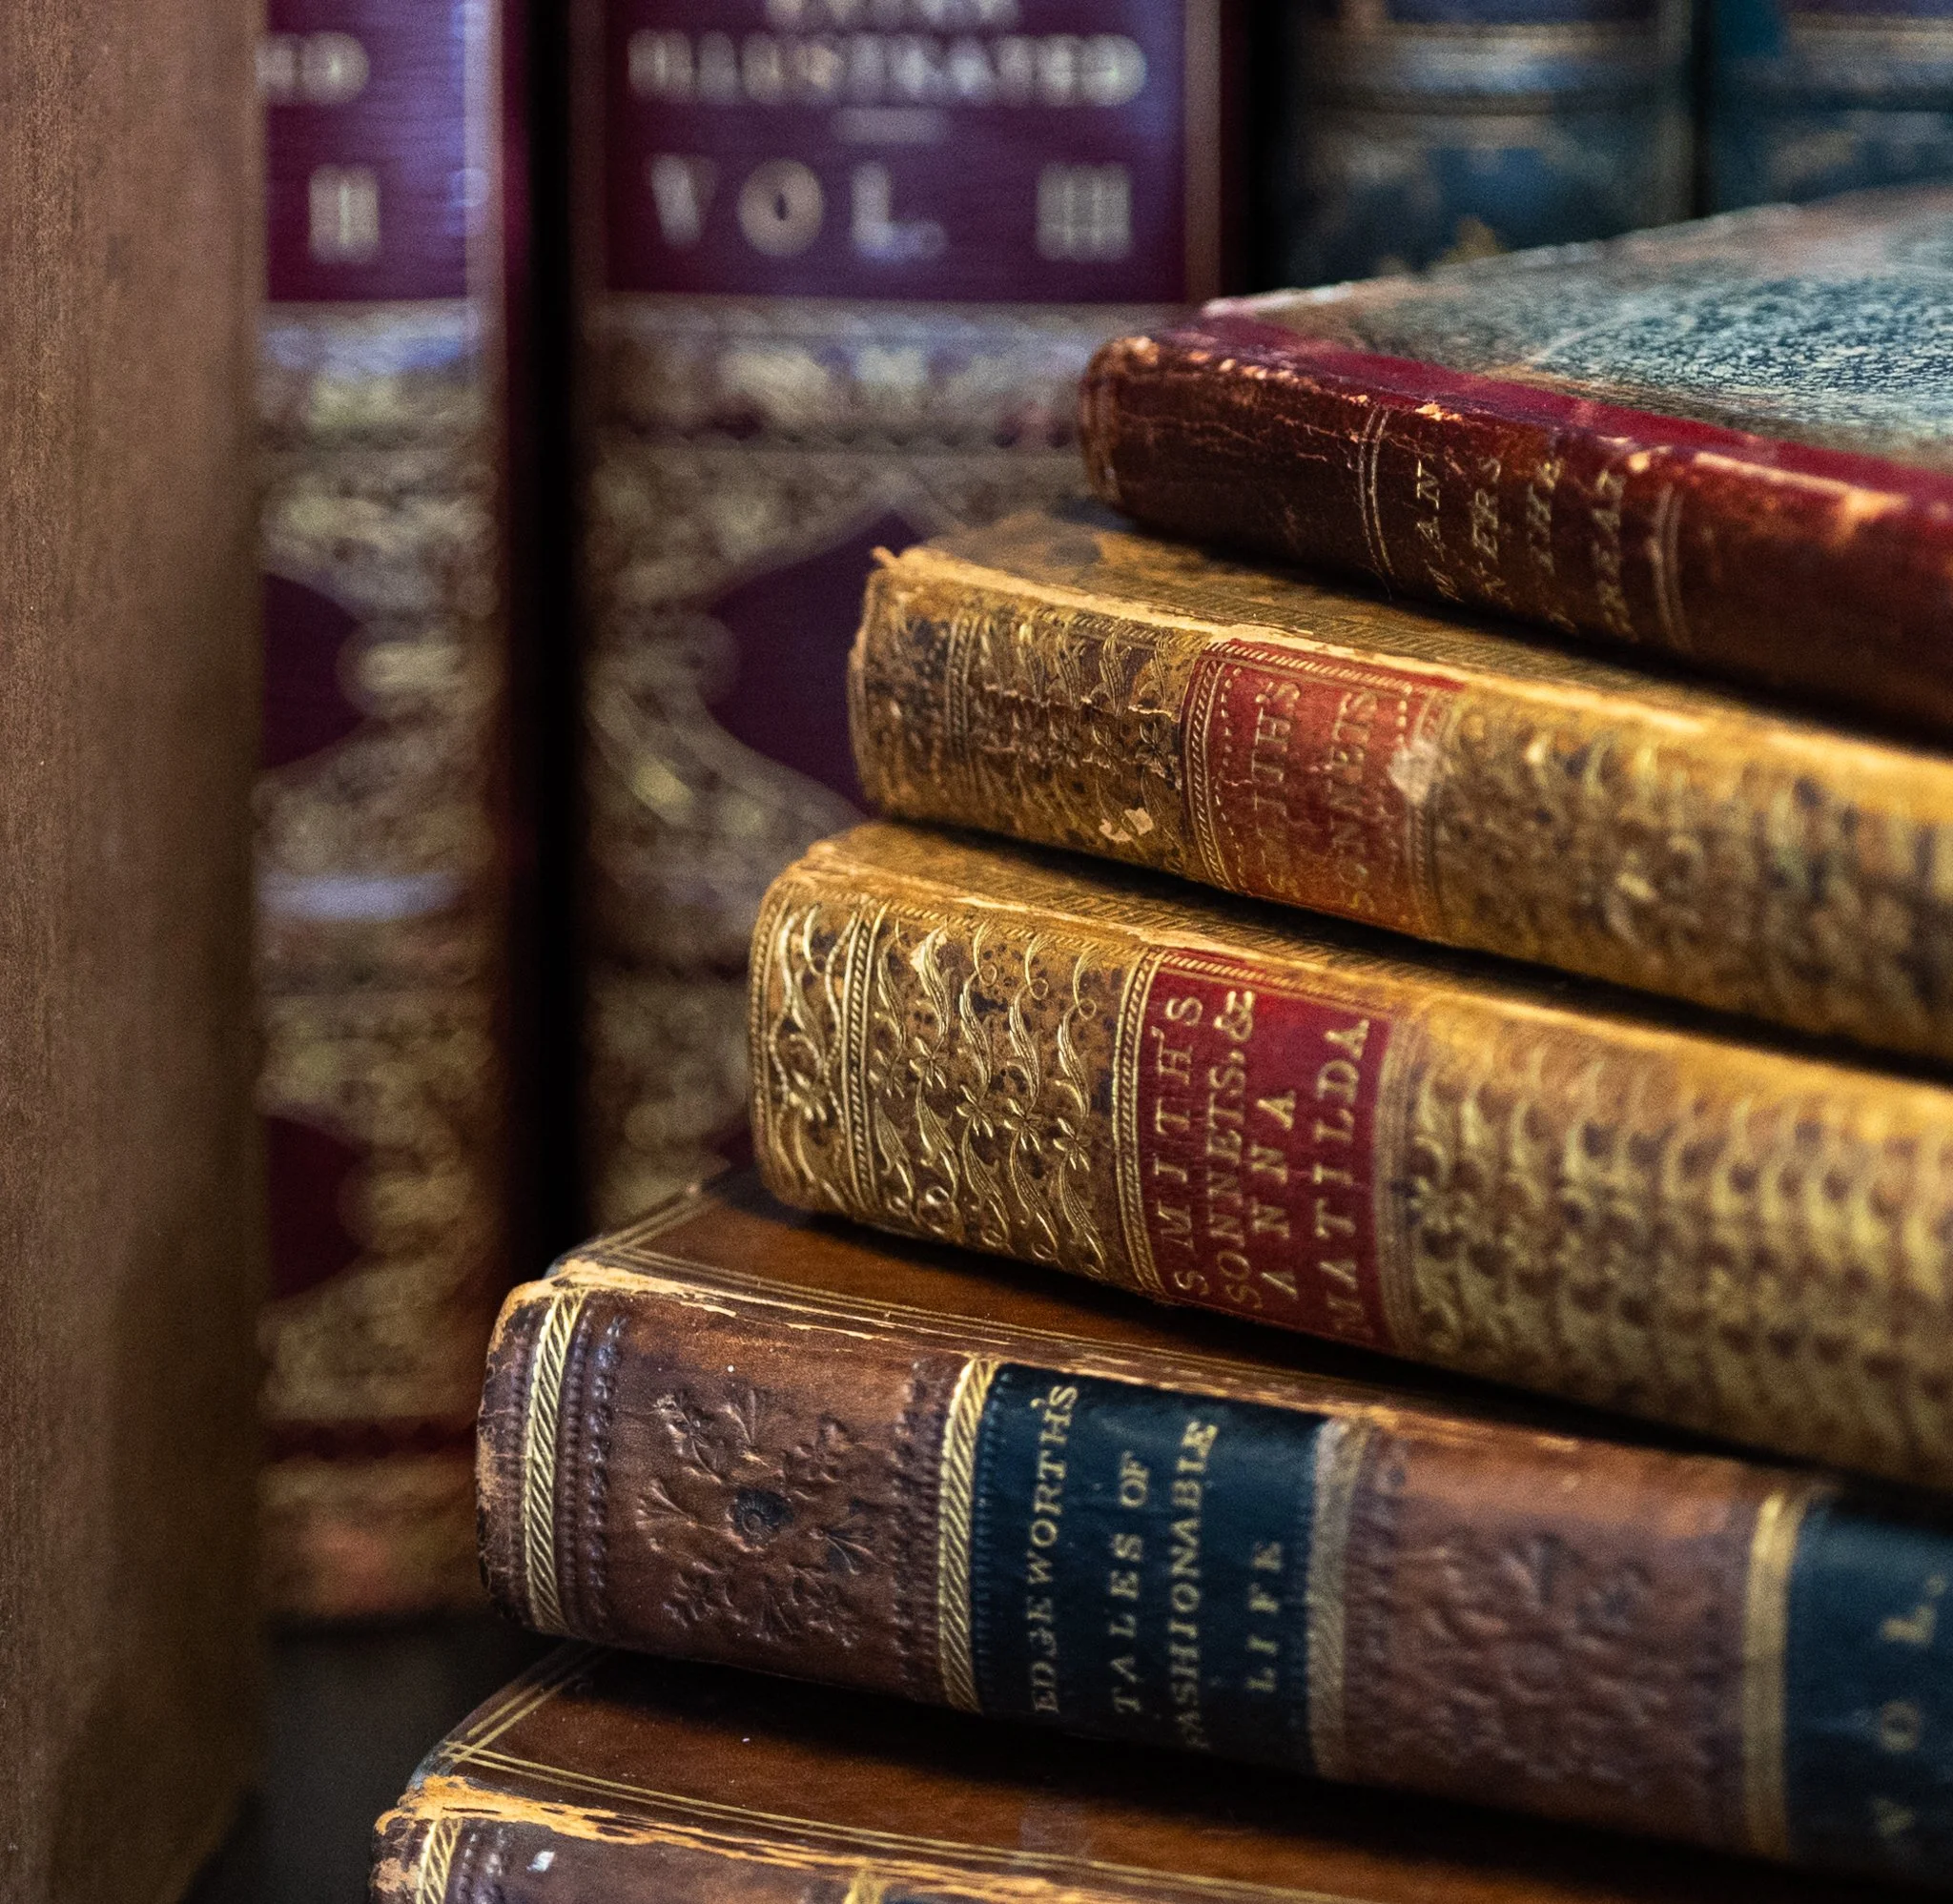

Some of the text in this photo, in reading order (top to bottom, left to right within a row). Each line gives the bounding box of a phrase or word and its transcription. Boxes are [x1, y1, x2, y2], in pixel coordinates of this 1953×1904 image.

[1151, 996, 1208, 1295] SMITH'S
[1250, 1091, 1299, 1300] ANNA
[1314, 1019, 1372, 1337] MATILDA
[1026, 1385, 1079, 1713] EDGEWORTH'S
[1109, 1450, 1149, 1713] TALES OF
[1167, 1421, 1219, 1750] FASHIONABLE
[1246, 1542, 1284, 1692] LIFE
